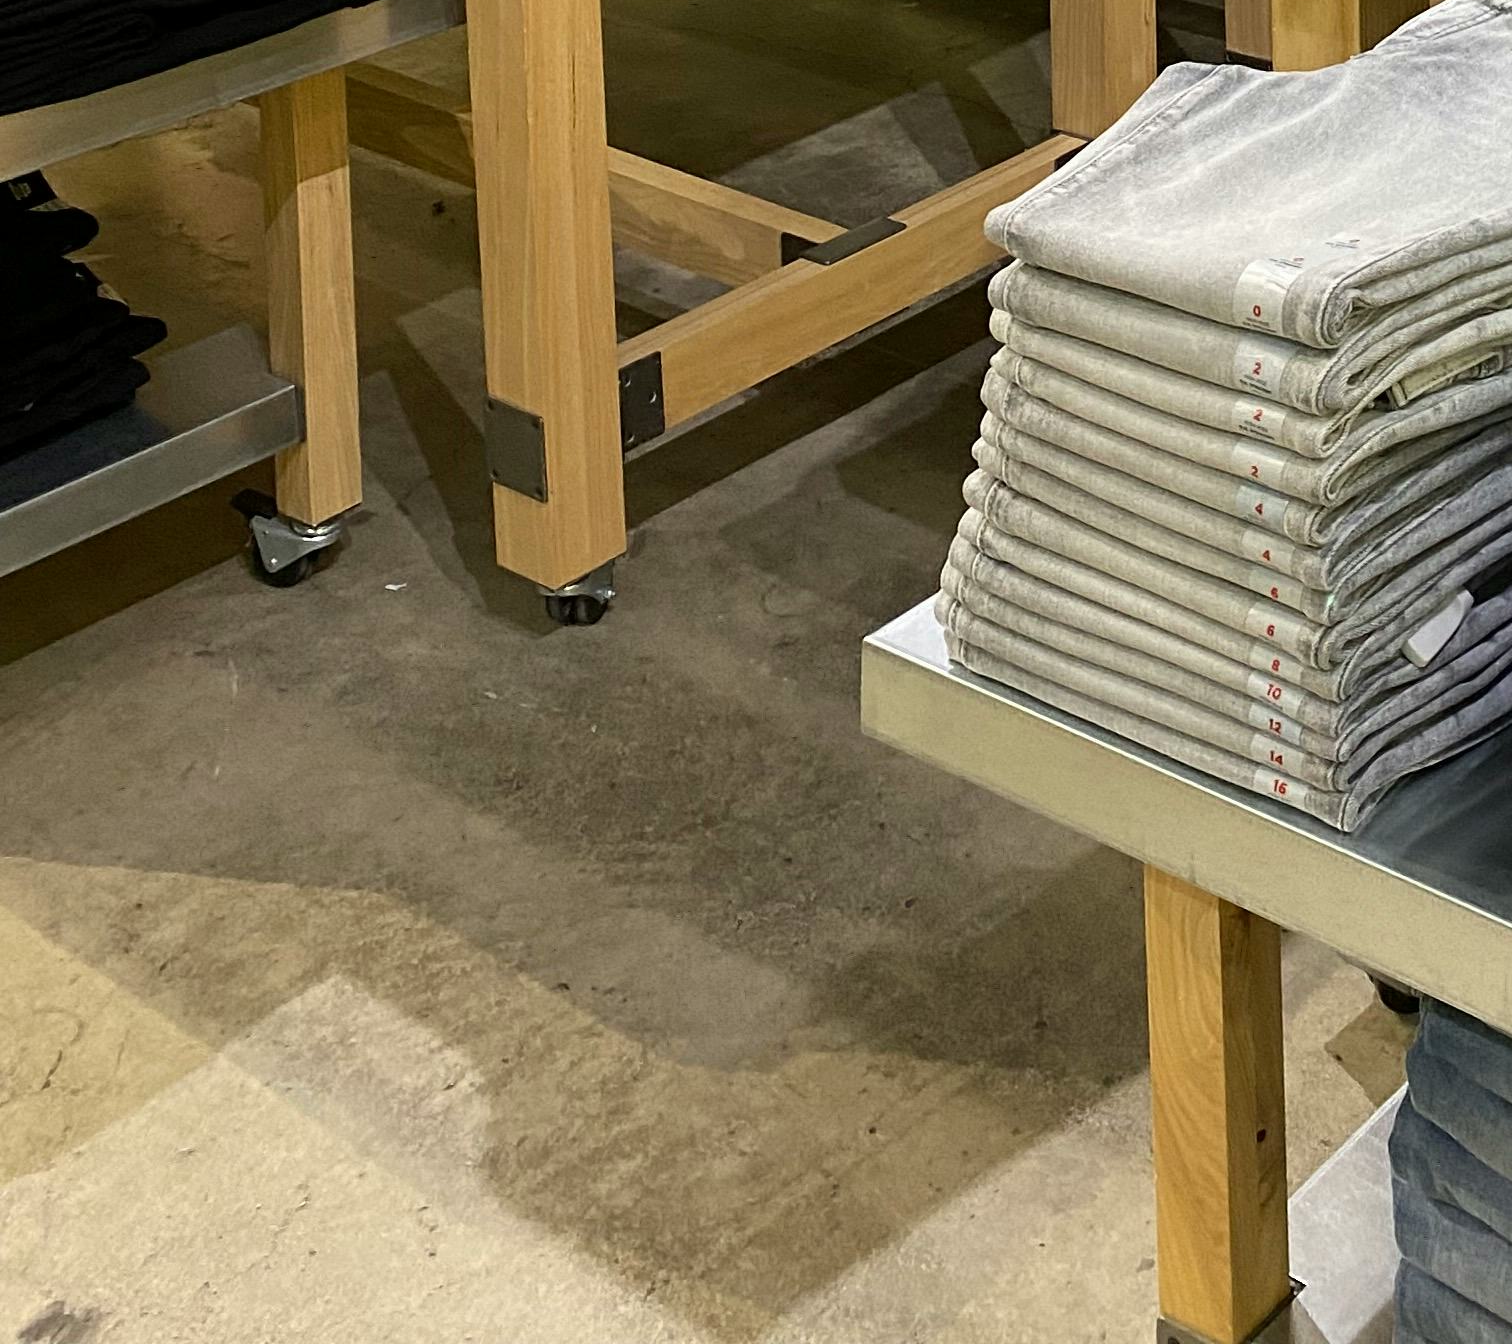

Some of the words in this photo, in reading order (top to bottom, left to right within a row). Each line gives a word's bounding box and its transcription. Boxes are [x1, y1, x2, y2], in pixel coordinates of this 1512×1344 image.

[1253, 305, 1261, 317] 0
[1267, 684, 1282, 700] 10
[1269, 719, 1282, 734] 12
[1273, 779, 1287, 795] 16
